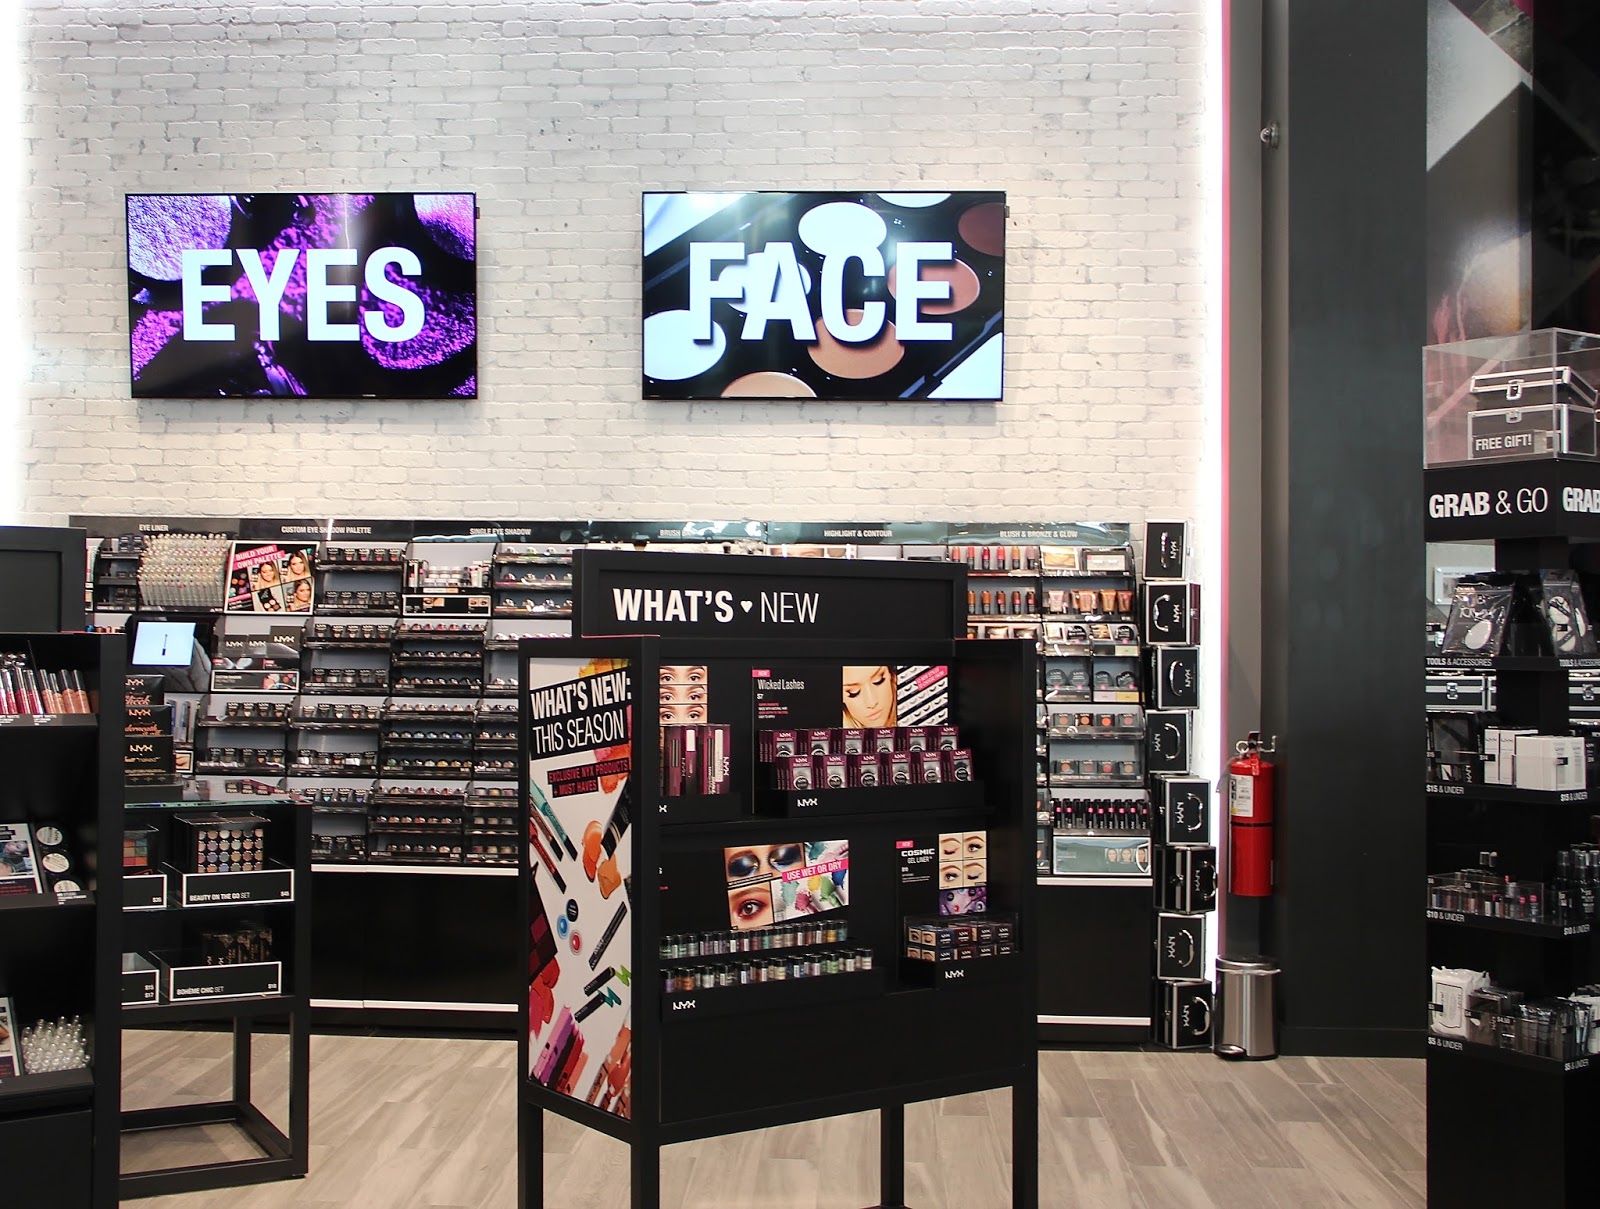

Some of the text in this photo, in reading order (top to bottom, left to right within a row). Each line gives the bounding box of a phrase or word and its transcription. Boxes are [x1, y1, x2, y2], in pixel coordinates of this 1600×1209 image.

[182, 247, 426, 342] EYES
[689, 241, 953, 342] FACE
[1475, 434, 1532, 451] FREE GIFT!
[1429, 487, 1548, 518] GRAB & GO
[1562, 486, 1600, 514] GRAB
[151, 524, 169, 532] LINER
[281, 525, 306, 533] CUSTOM
[307, 526, 319, 534] EYE
[346, 526, 372, 534] PALETTE
[999, 530, 1020, 538] BLUSH
[236, 546, 274, 561] BUILD YOUR
[237, 553, 282, 569] OWN PALETTE
[612, 588, 820, 624] WHAT'S NEW
[1173, 604, 1181, 623] NYX
[225, 641, 244, 649] NYX
[249, 640, 267, 648] NYX
[273, 635, 295, 644] NYX
[1426, 657, 1446, 665] TOOLS
[1452, 658, 1492, 667] ACCESSORIES
[757, 679, 805, 690] Wicked Lashes
[530, 671, 632, 720] WHAT'S NEW:
[532, 709, 625, 754] THIS SEASON
[129, 744, 153, 752] NYX
[549, 760, 628, 783] EXCLUSIVE NYX PRODUCTS
[559, 783, 576, 795] MUST
[577, 780, 597, 792] HAVES
[1426, 784, 1438, 793] $15
[1444, 786, 1464, 795] UNDER
[797, 798, 818, 808] NYX
[1176, 801, 1184, 824] NYX
[901, 848, 935, 857] COSMIC
[786, 861, 842, 881] USE WET OR DRY
[1426, 910, 1438, 919] $10
[1444, 912, 1465, 922] UNDER
[1167, 936, 1175, 958] NYX
[945, 970, 964, 979] NYX
[673, 1000, 696, 1010] NYX
[1427, 1036, 1436, 1045] $5
[1442, 1040, 1463, 1051] UNDER
